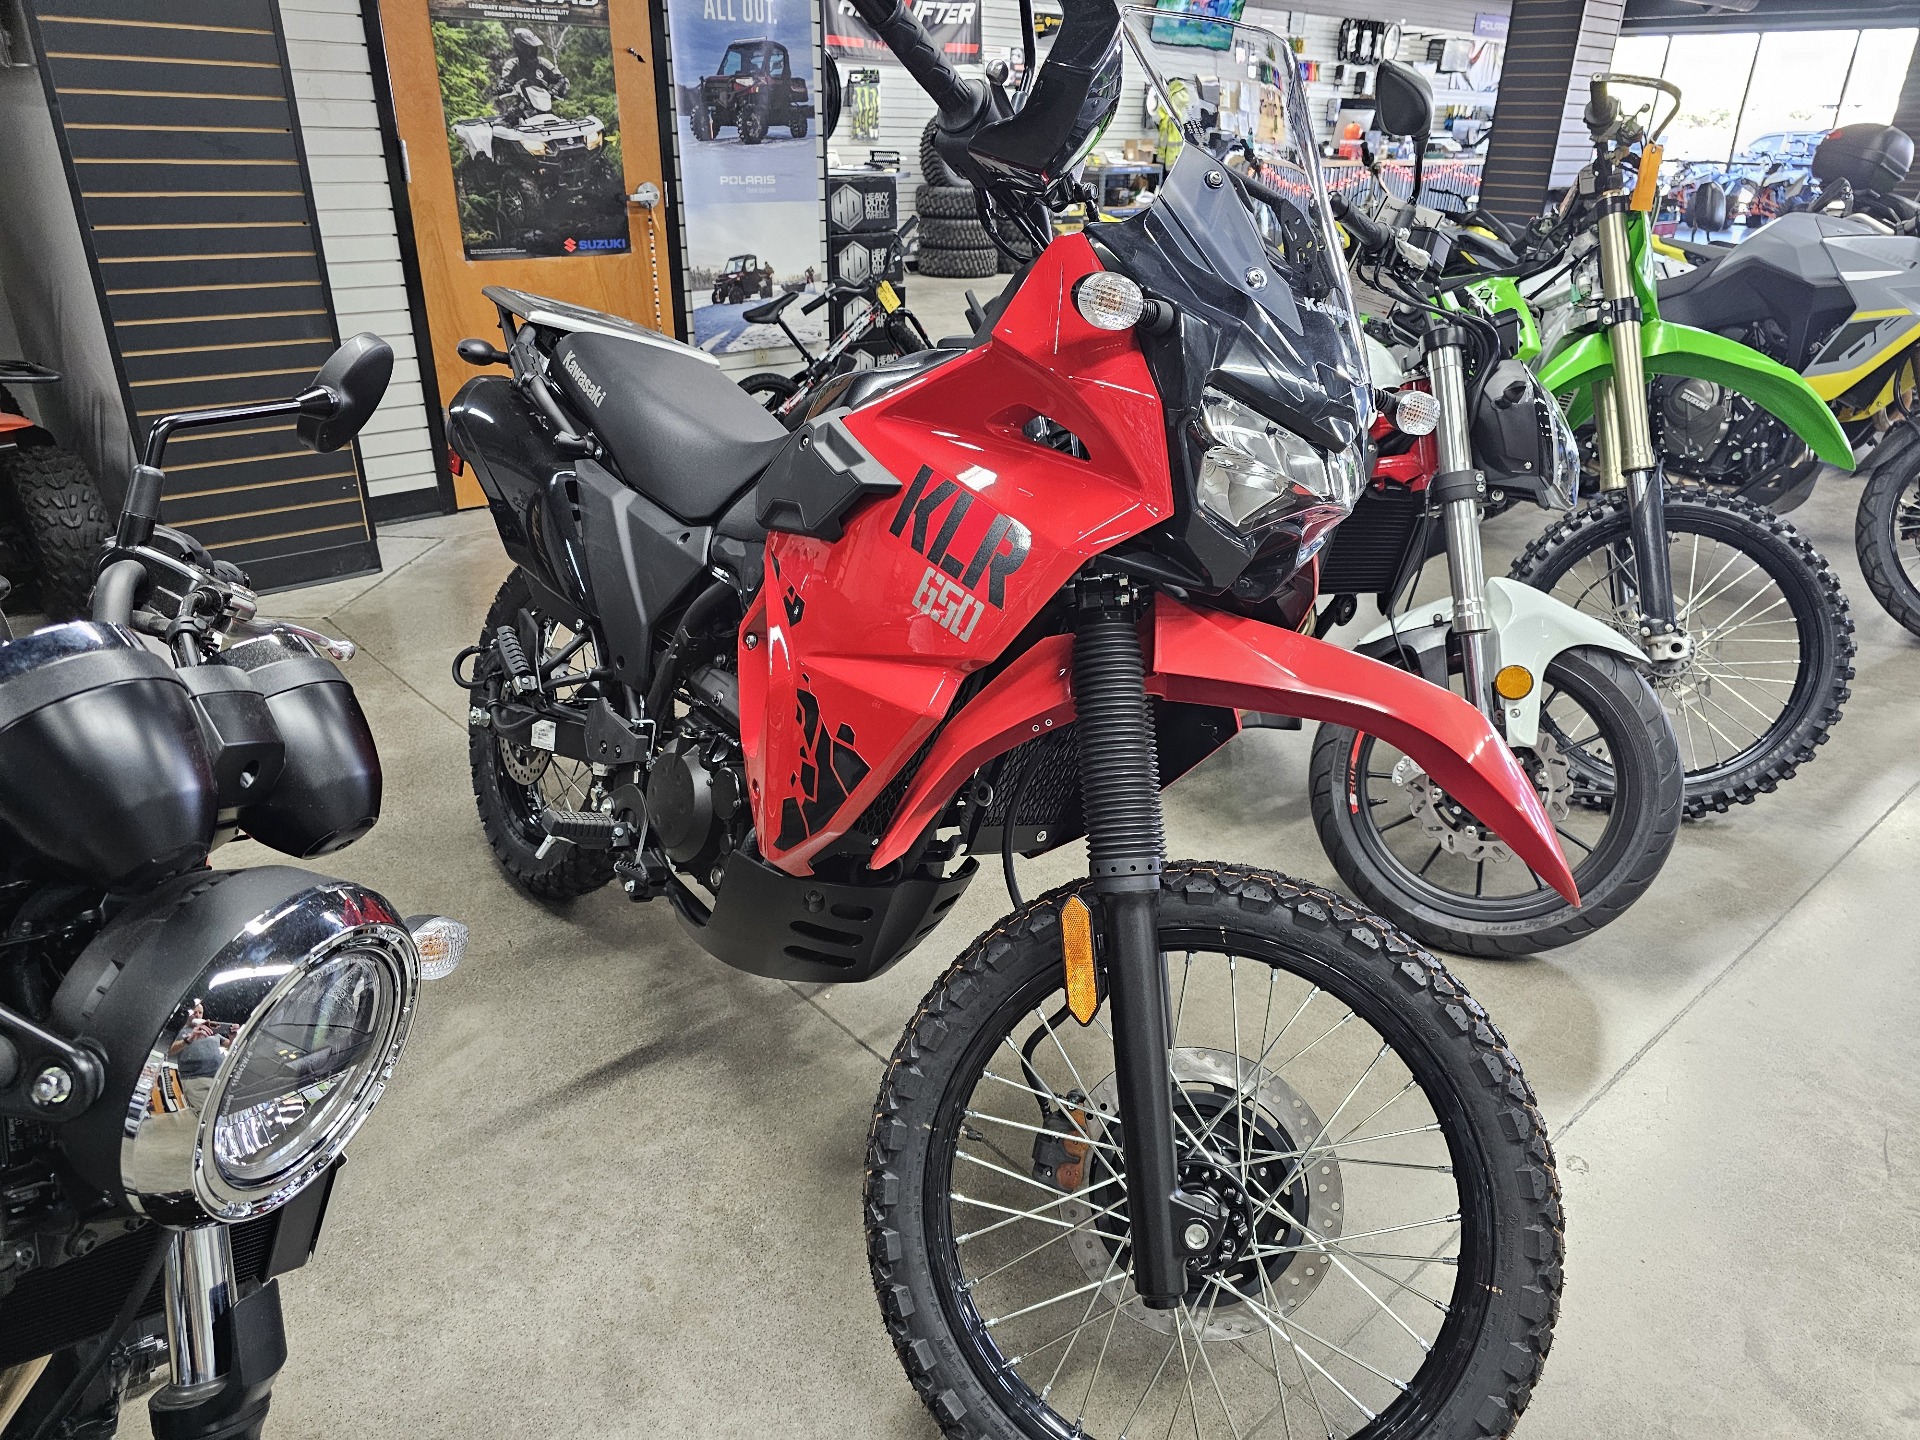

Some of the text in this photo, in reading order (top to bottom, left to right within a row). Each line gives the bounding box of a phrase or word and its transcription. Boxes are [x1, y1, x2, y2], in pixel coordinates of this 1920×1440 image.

[703, 0, 777, 24] ALL OUT.
[912, 1, 976, 24] IFTER
[719, 175, 776, 186] POLARIS
[865, 192, 889, 200] HEAVY
[865, 199, 889, 207] DUTY
[865, 206, 889, 214] ALLOY
[866, 211, 890, 219] WHEELS
[578, 238, 625, 249] SUZUKI
[563, 350, 607, 408] Kawasaki
[1681, 392, 1711, 411] SUZUKI
[889, 463, 1032, 610] KLR
[911, 566, 985, 643] 650
